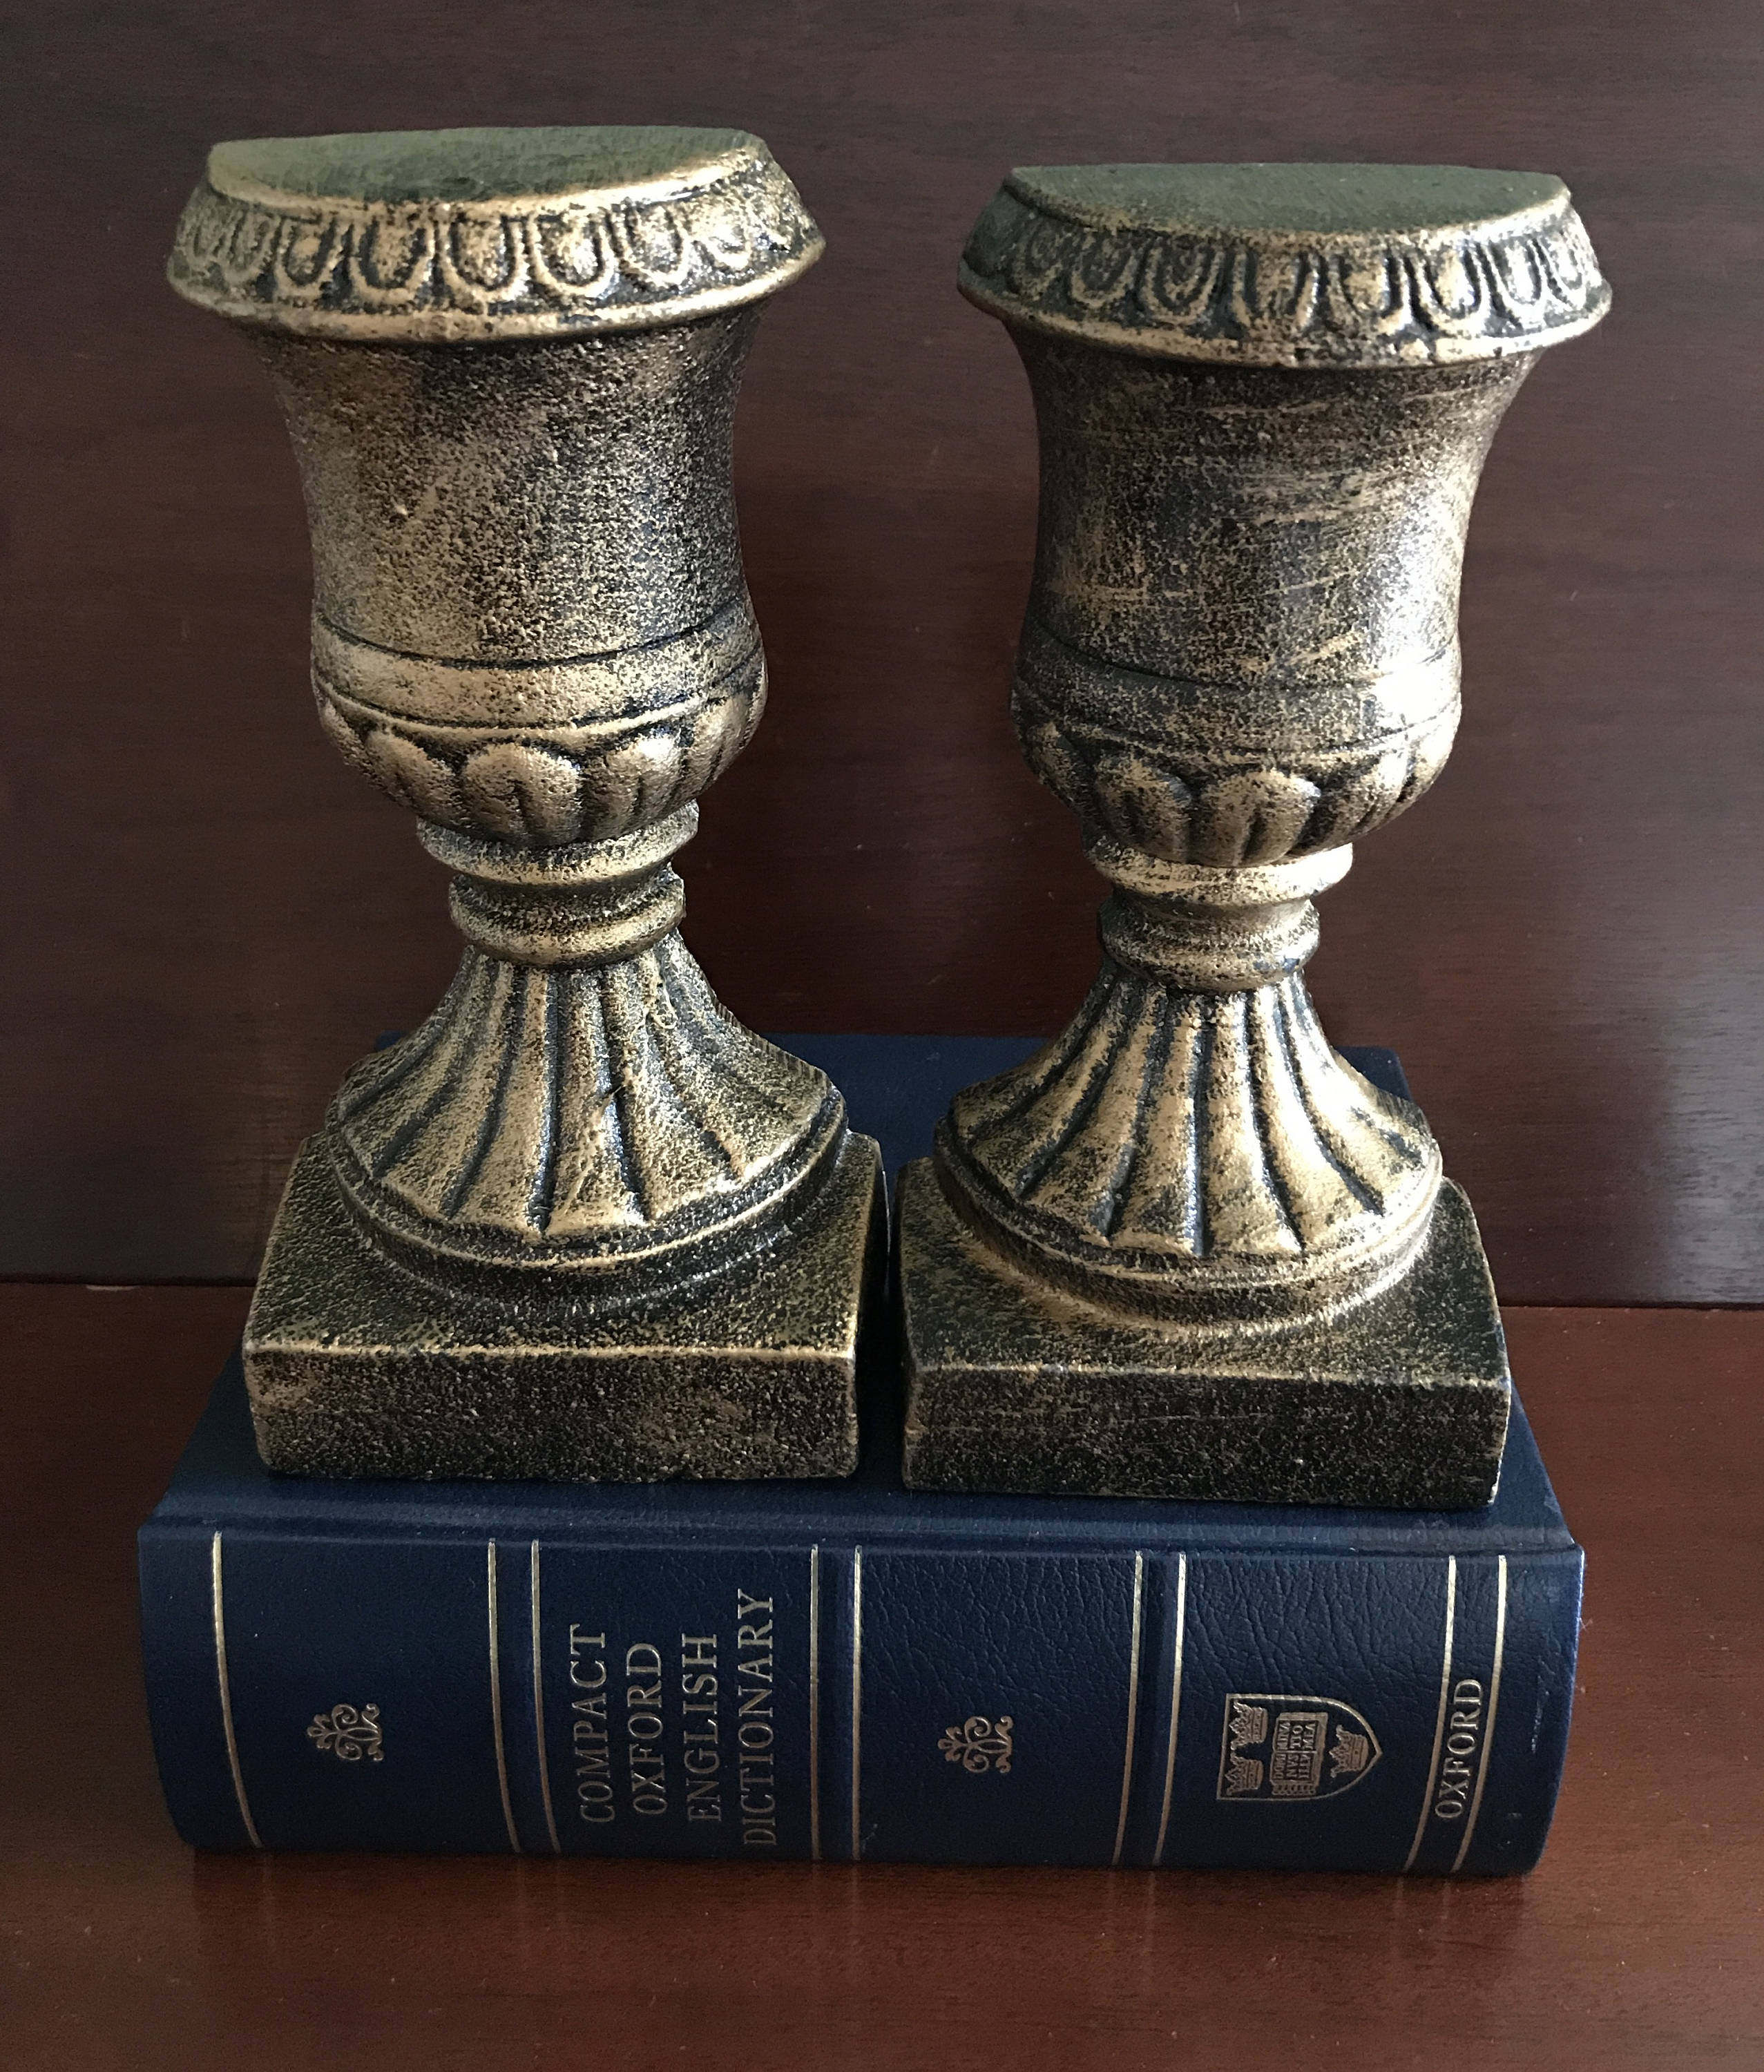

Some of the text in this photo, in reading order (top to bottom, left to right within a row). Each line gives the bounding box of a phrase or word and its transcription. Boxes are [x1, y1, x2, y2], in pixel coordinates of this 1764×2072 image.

[570, 1623, 615, 1822] COMPACT
[626, 1642, 668, 1814] OXFORD
[681, 1633, 722, 1821] ENGLISH
[738, 1588, 777, 1845] DICTIONARY
[1435, 1678, 1482, 1819] OXFORD
